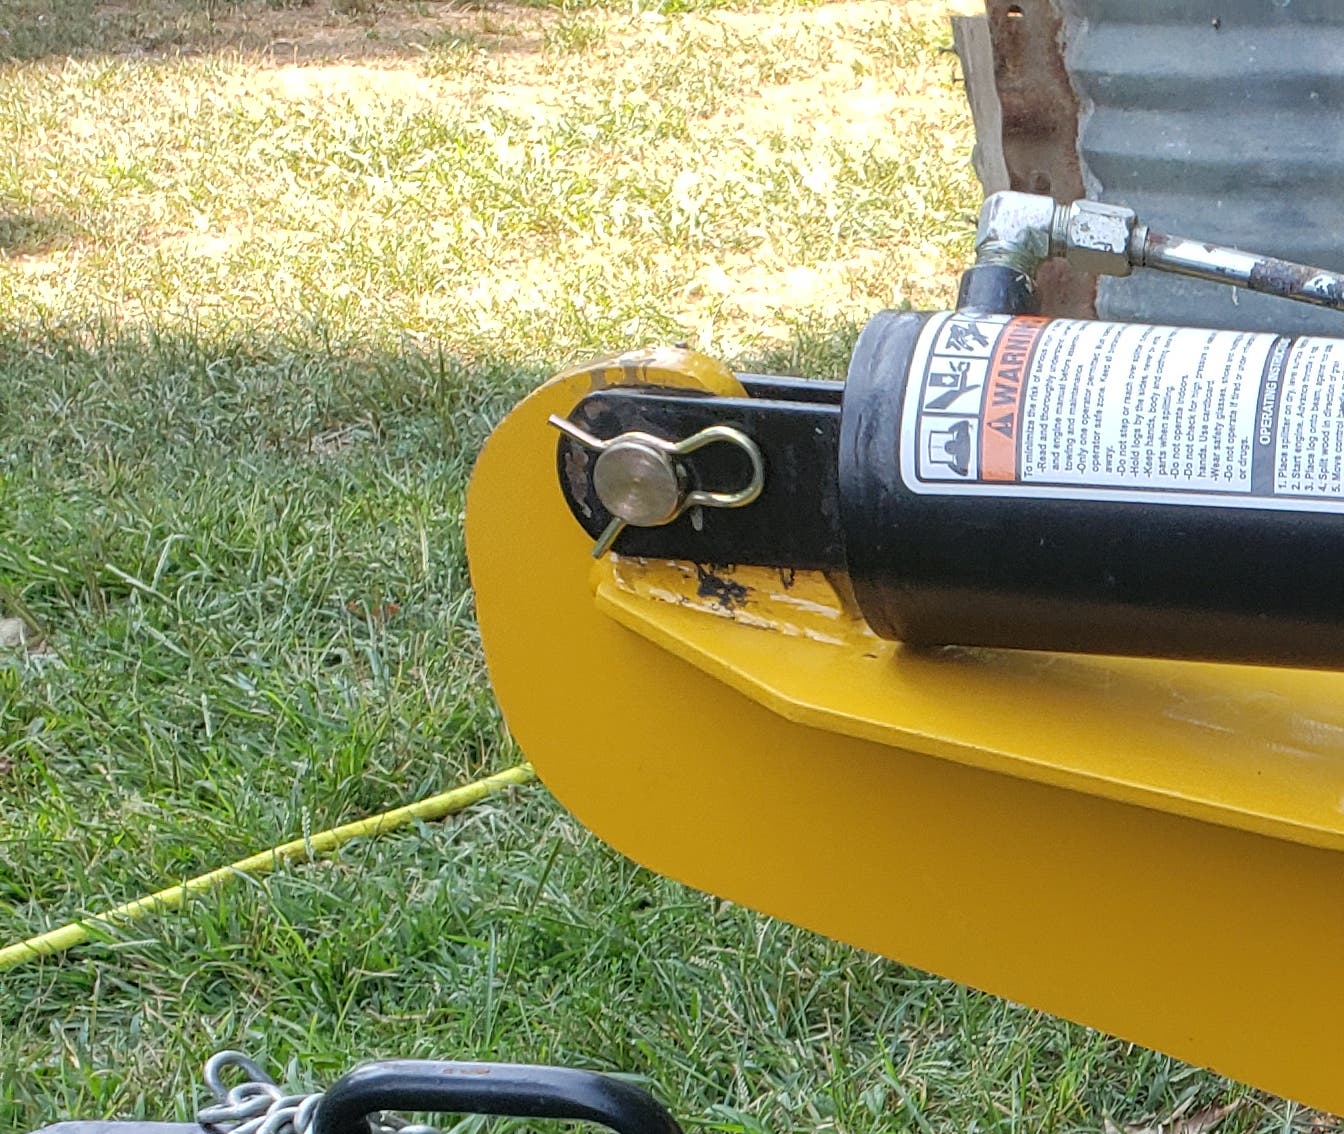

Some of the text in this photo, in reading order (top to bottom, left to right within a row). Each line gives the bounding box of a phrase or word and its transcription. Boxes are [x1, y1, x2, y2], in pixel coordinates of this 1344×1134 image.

[1260, 382, 1278, 445] OPERATING
[1039, 424, 1047, 440] and
[1119, 419, 1129, 438] step
[1171, 407, 1184, 459] not operate
[1186, 416, 1195, 441] check
[1199, 425, 1209, 442] Use
[1212, 423, 1224, 450] safety
[1226, 410, 1237, 443] operate
[1064, 419, 1075, 470] towing and
[1092, 410, 1102, 472] operator safe
[1118, 441, 1126, 456] not
[1132, 428, 1142, 448] logs
[1158, 423, 1168, 475] parts when
[1307, 437, 1318, 451] log
[1321, 431, 1330, 455] wood
[1052, 452, 1060, 470] and
[1185, 444, 1194, 459] not
[1225, 446, 1234, 461] not
[1293, 456, 1301, 479] Start
[1319, 458, 1329, 480] Split
